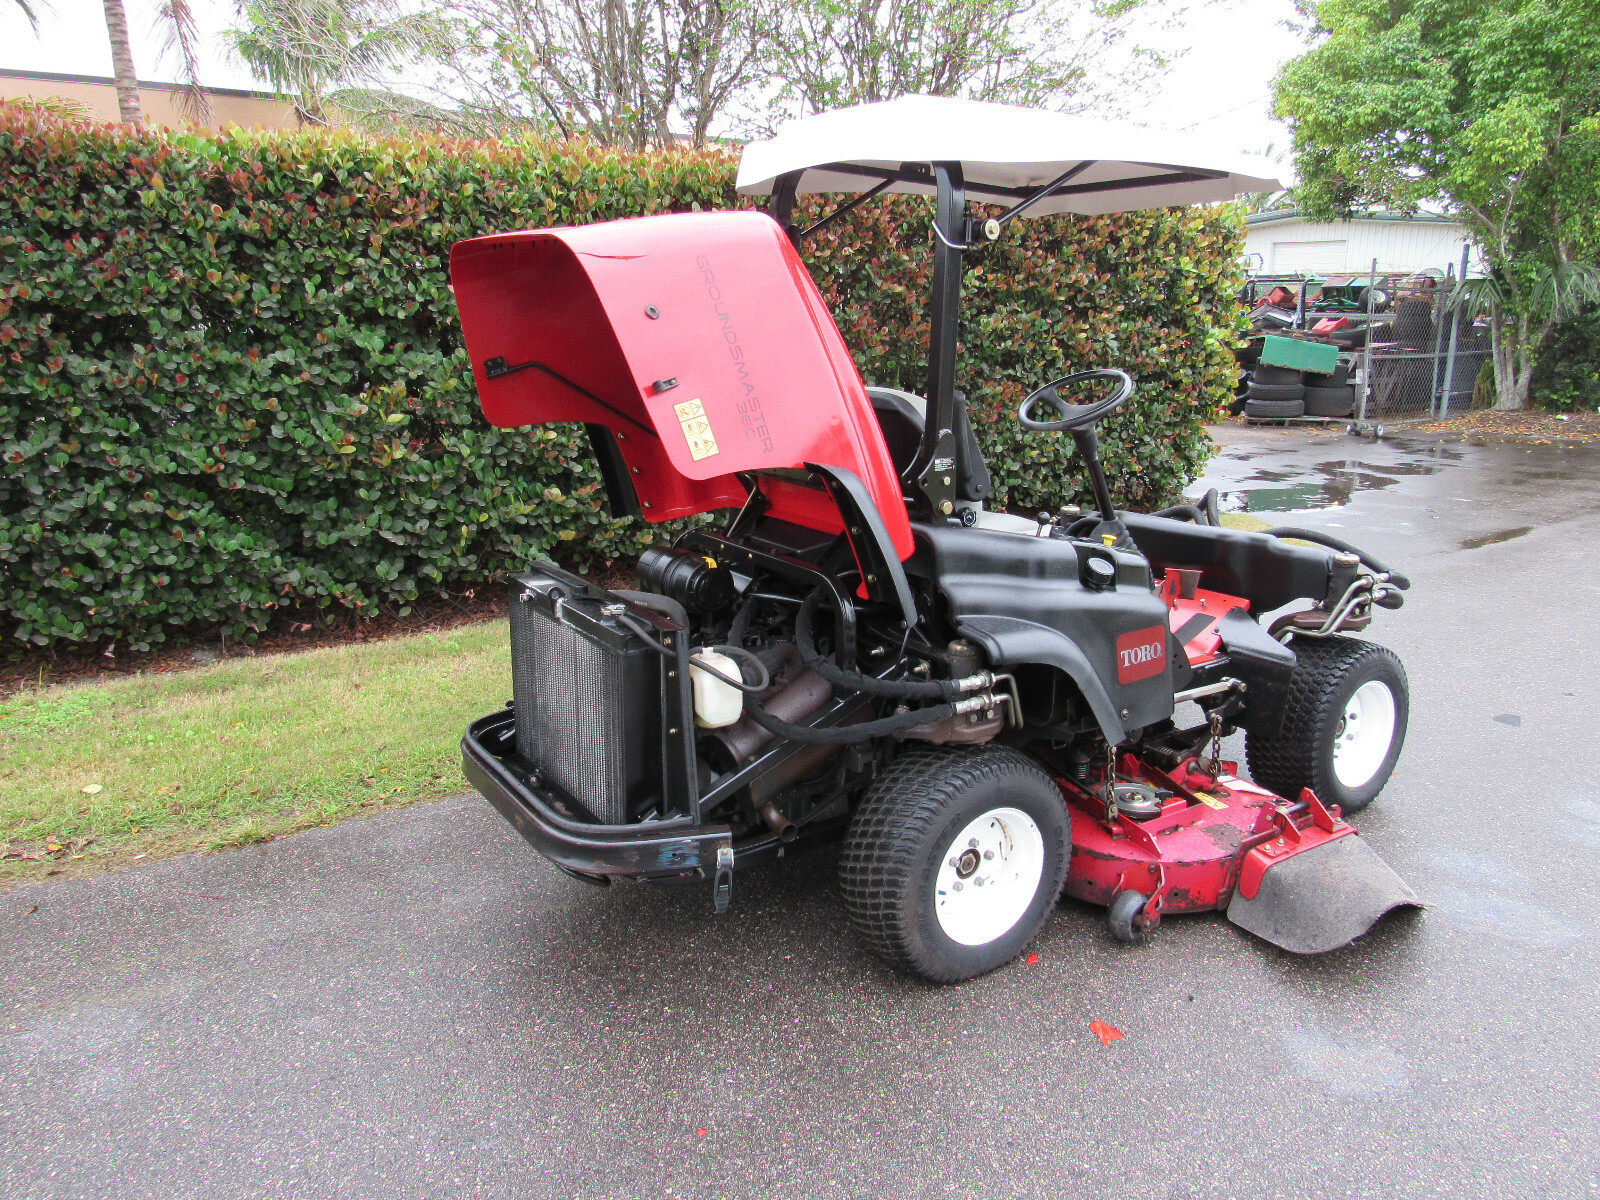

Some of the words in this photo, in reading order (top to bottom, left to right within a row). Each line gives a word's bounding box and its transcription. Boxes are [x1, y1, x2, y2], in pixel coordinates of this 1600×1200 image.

[696, 254, 774, 453] GROUNDSMASTER
[736, 401, 756, 441] 360
[1120, 642, 1162, 668] TORO
